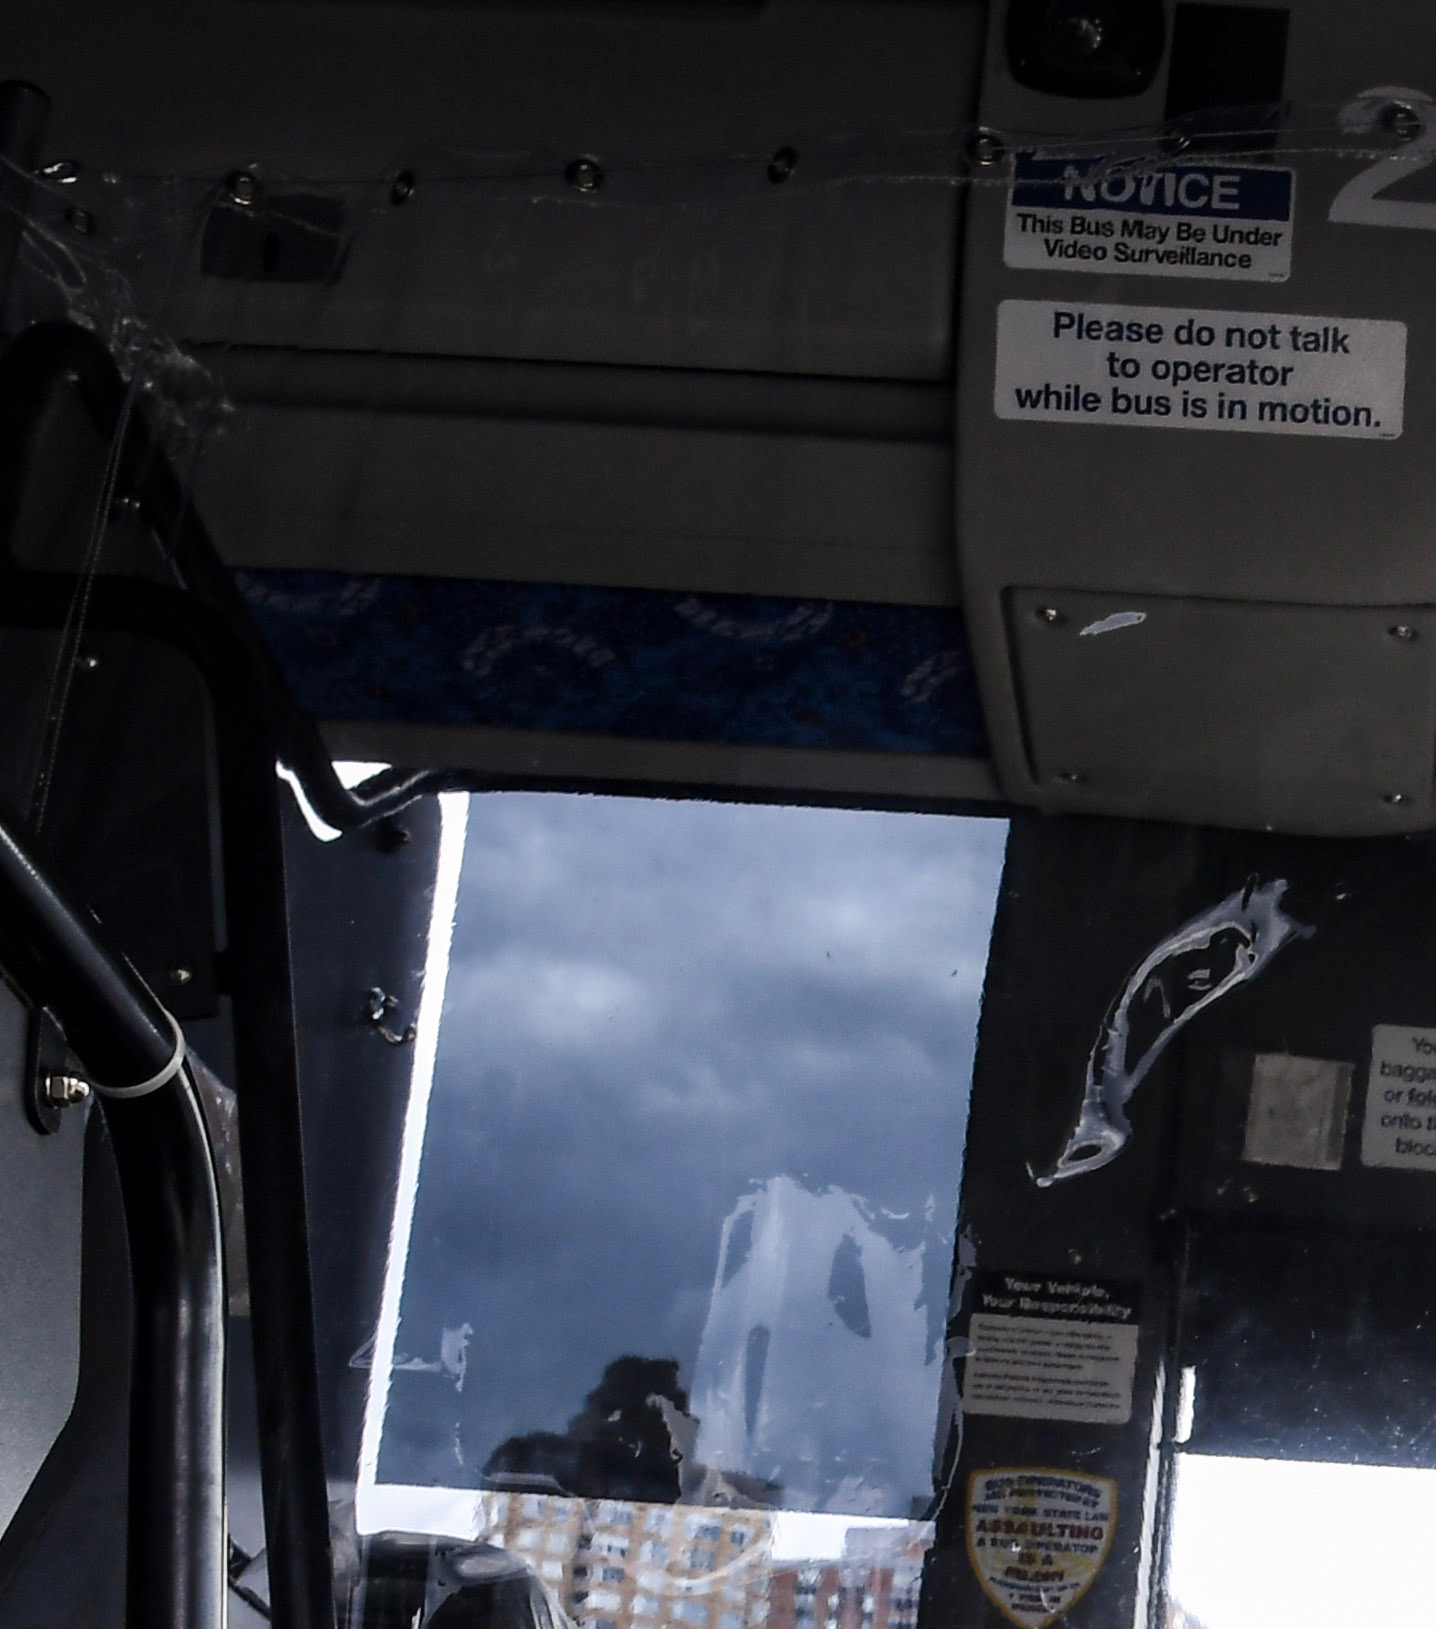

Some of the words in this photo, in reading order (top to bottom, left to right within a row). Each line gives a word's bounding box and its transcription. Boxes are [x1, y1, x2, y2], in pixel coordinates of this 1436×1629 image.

[1062, 165, 1240, 210] NOTICE
[1018, 214, 1062, 234] This
[1071, 218, 1114, 238] Bus
[1121, 220, 1169, 243] May
[1177, 223, 1205, 242] Be
[1213, 226, 1282, 246] Under
[1045, 239, 1106, 260] Video
[1114, 243, 1251, 268] Surveillance
[1054, 312, 1163, 344] Please
[1175, 320, 1214, 346] do
[1225, 325, 1281, 349] not
[1290, 326, 1349, 354] talk
[1108, 352, 1140, 378] to
[1152, 359, 1293, 386] operator
[1016, 385, 1100, 412] while
[1112, 387, 1170, 416] bus
[1182, 391, 1207, 418] is
[1219, 392, 1246, 419] in
[1259, 398, 1380, 427] motion.
[1384, 1090, 1403, 1102] or
[1381, 1113, 1421, 1130] onto
[1005, 1276, 1041, 1292] Your
[982, 1293, 1014, 1308] Your
[977, 1520, 1103, 1540] ASSAULTING
